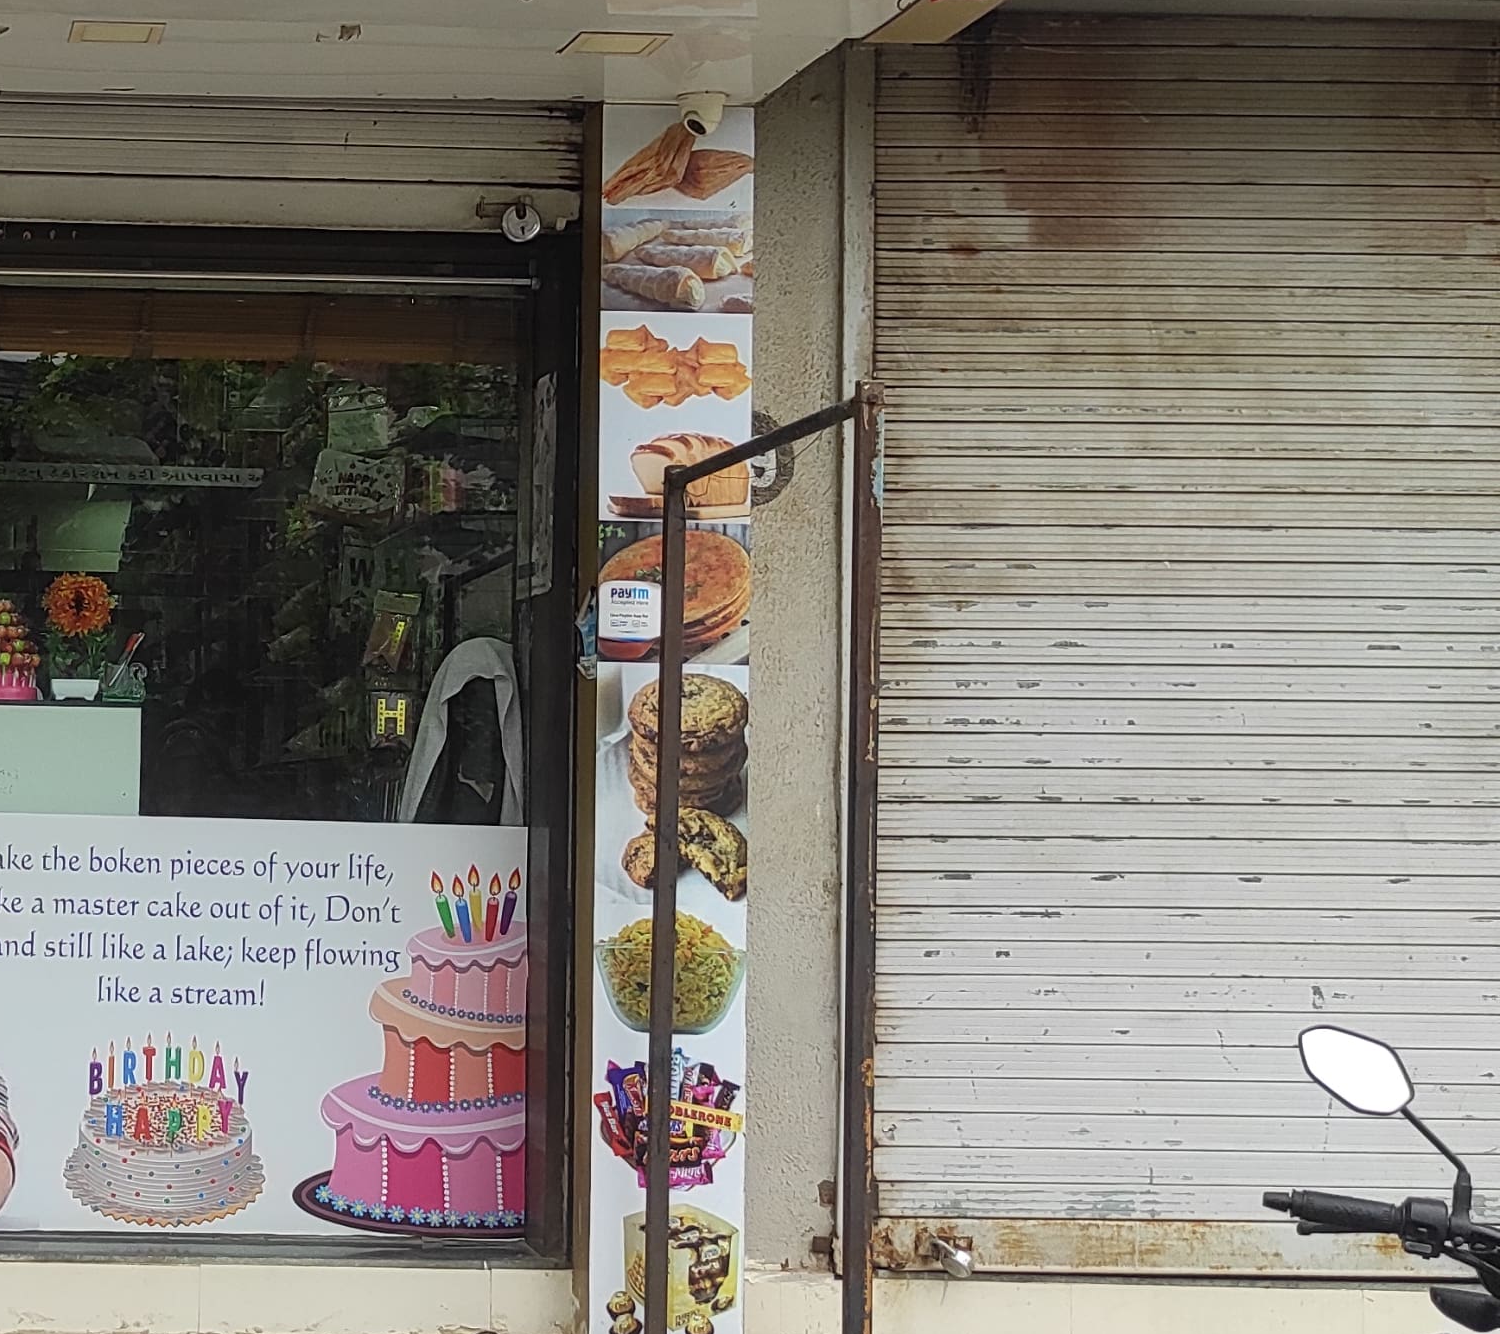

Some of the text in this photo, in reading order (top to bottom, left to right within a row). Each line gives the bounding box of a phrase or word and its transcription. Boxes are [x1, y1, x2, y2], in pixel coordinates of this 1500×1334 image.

[43, 844, 81, 872] the
[90, 846, 161, 874] boken
[170, 851, 245, 882] pieces
[252, 847, 278, 879] of
[284, 859, 339, 884] your
[347, 845, 395, 884] life,
[32, 898, 45, 913] a
[54, 896, 140, 917] master
[148, 892, 202, 918] cake
[211, 899, 250, 921] out
[259, 895, 284, 925] of
[291, 896, 316, 927] it,
[325, 896, 402, 925] Don't
[44, 932, 93, 959] still
[102, 932, 145, 960] like
[153, 944, 166, 960] a
[177, 935, 232, 968] lake;
[243, 936, 296, 971] keep
[305, 938, 401, 973] flowing
[98, 976, 265, 1007] like a stream!
[89, 1046, 249, 1105] BIRTHDAY
[106, 1099, 233, 1143] HAPPY
[670, 1104, 732, 1127] OBLERONE
